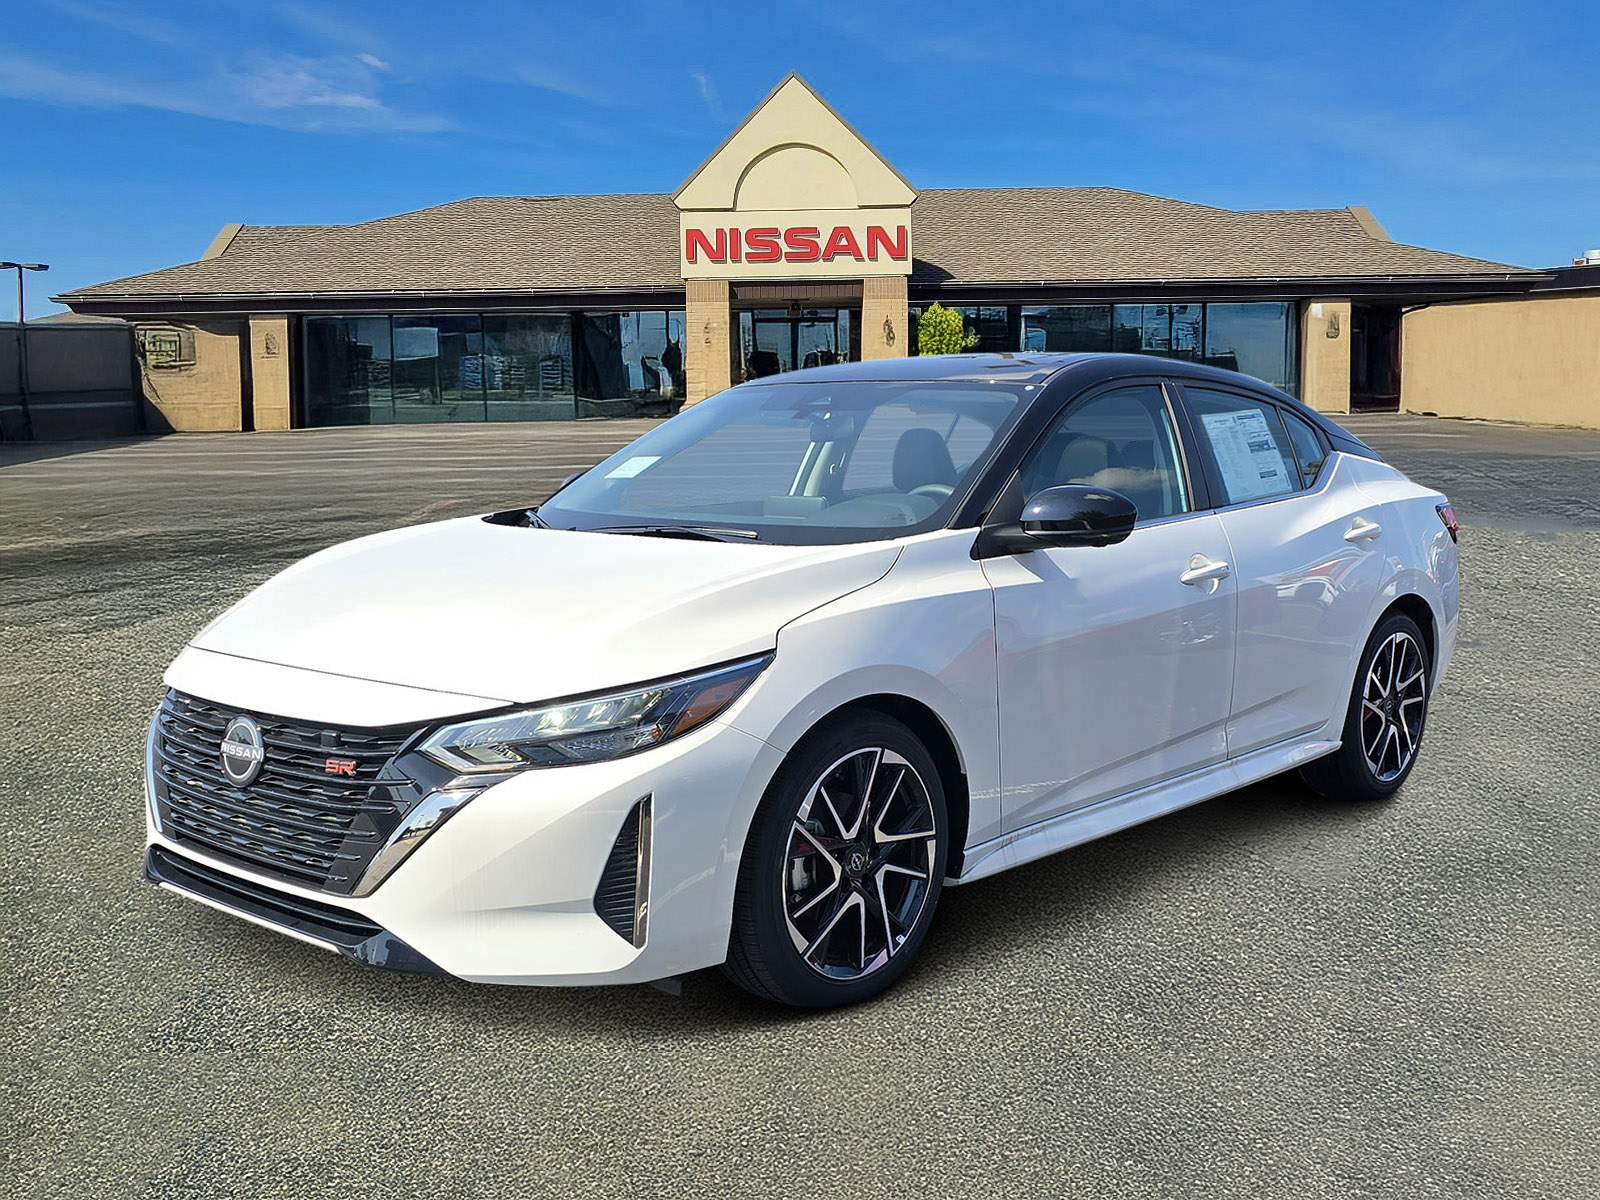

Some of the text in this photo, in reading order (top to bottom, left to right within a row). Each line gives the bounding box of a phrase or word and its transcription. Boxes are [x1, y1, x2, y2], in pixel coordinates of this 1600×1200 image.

[685, 225, 908, 263] NISSAN
[220, 741, 261, 760] NISSAN
[325, 759, 356, 776] SR
